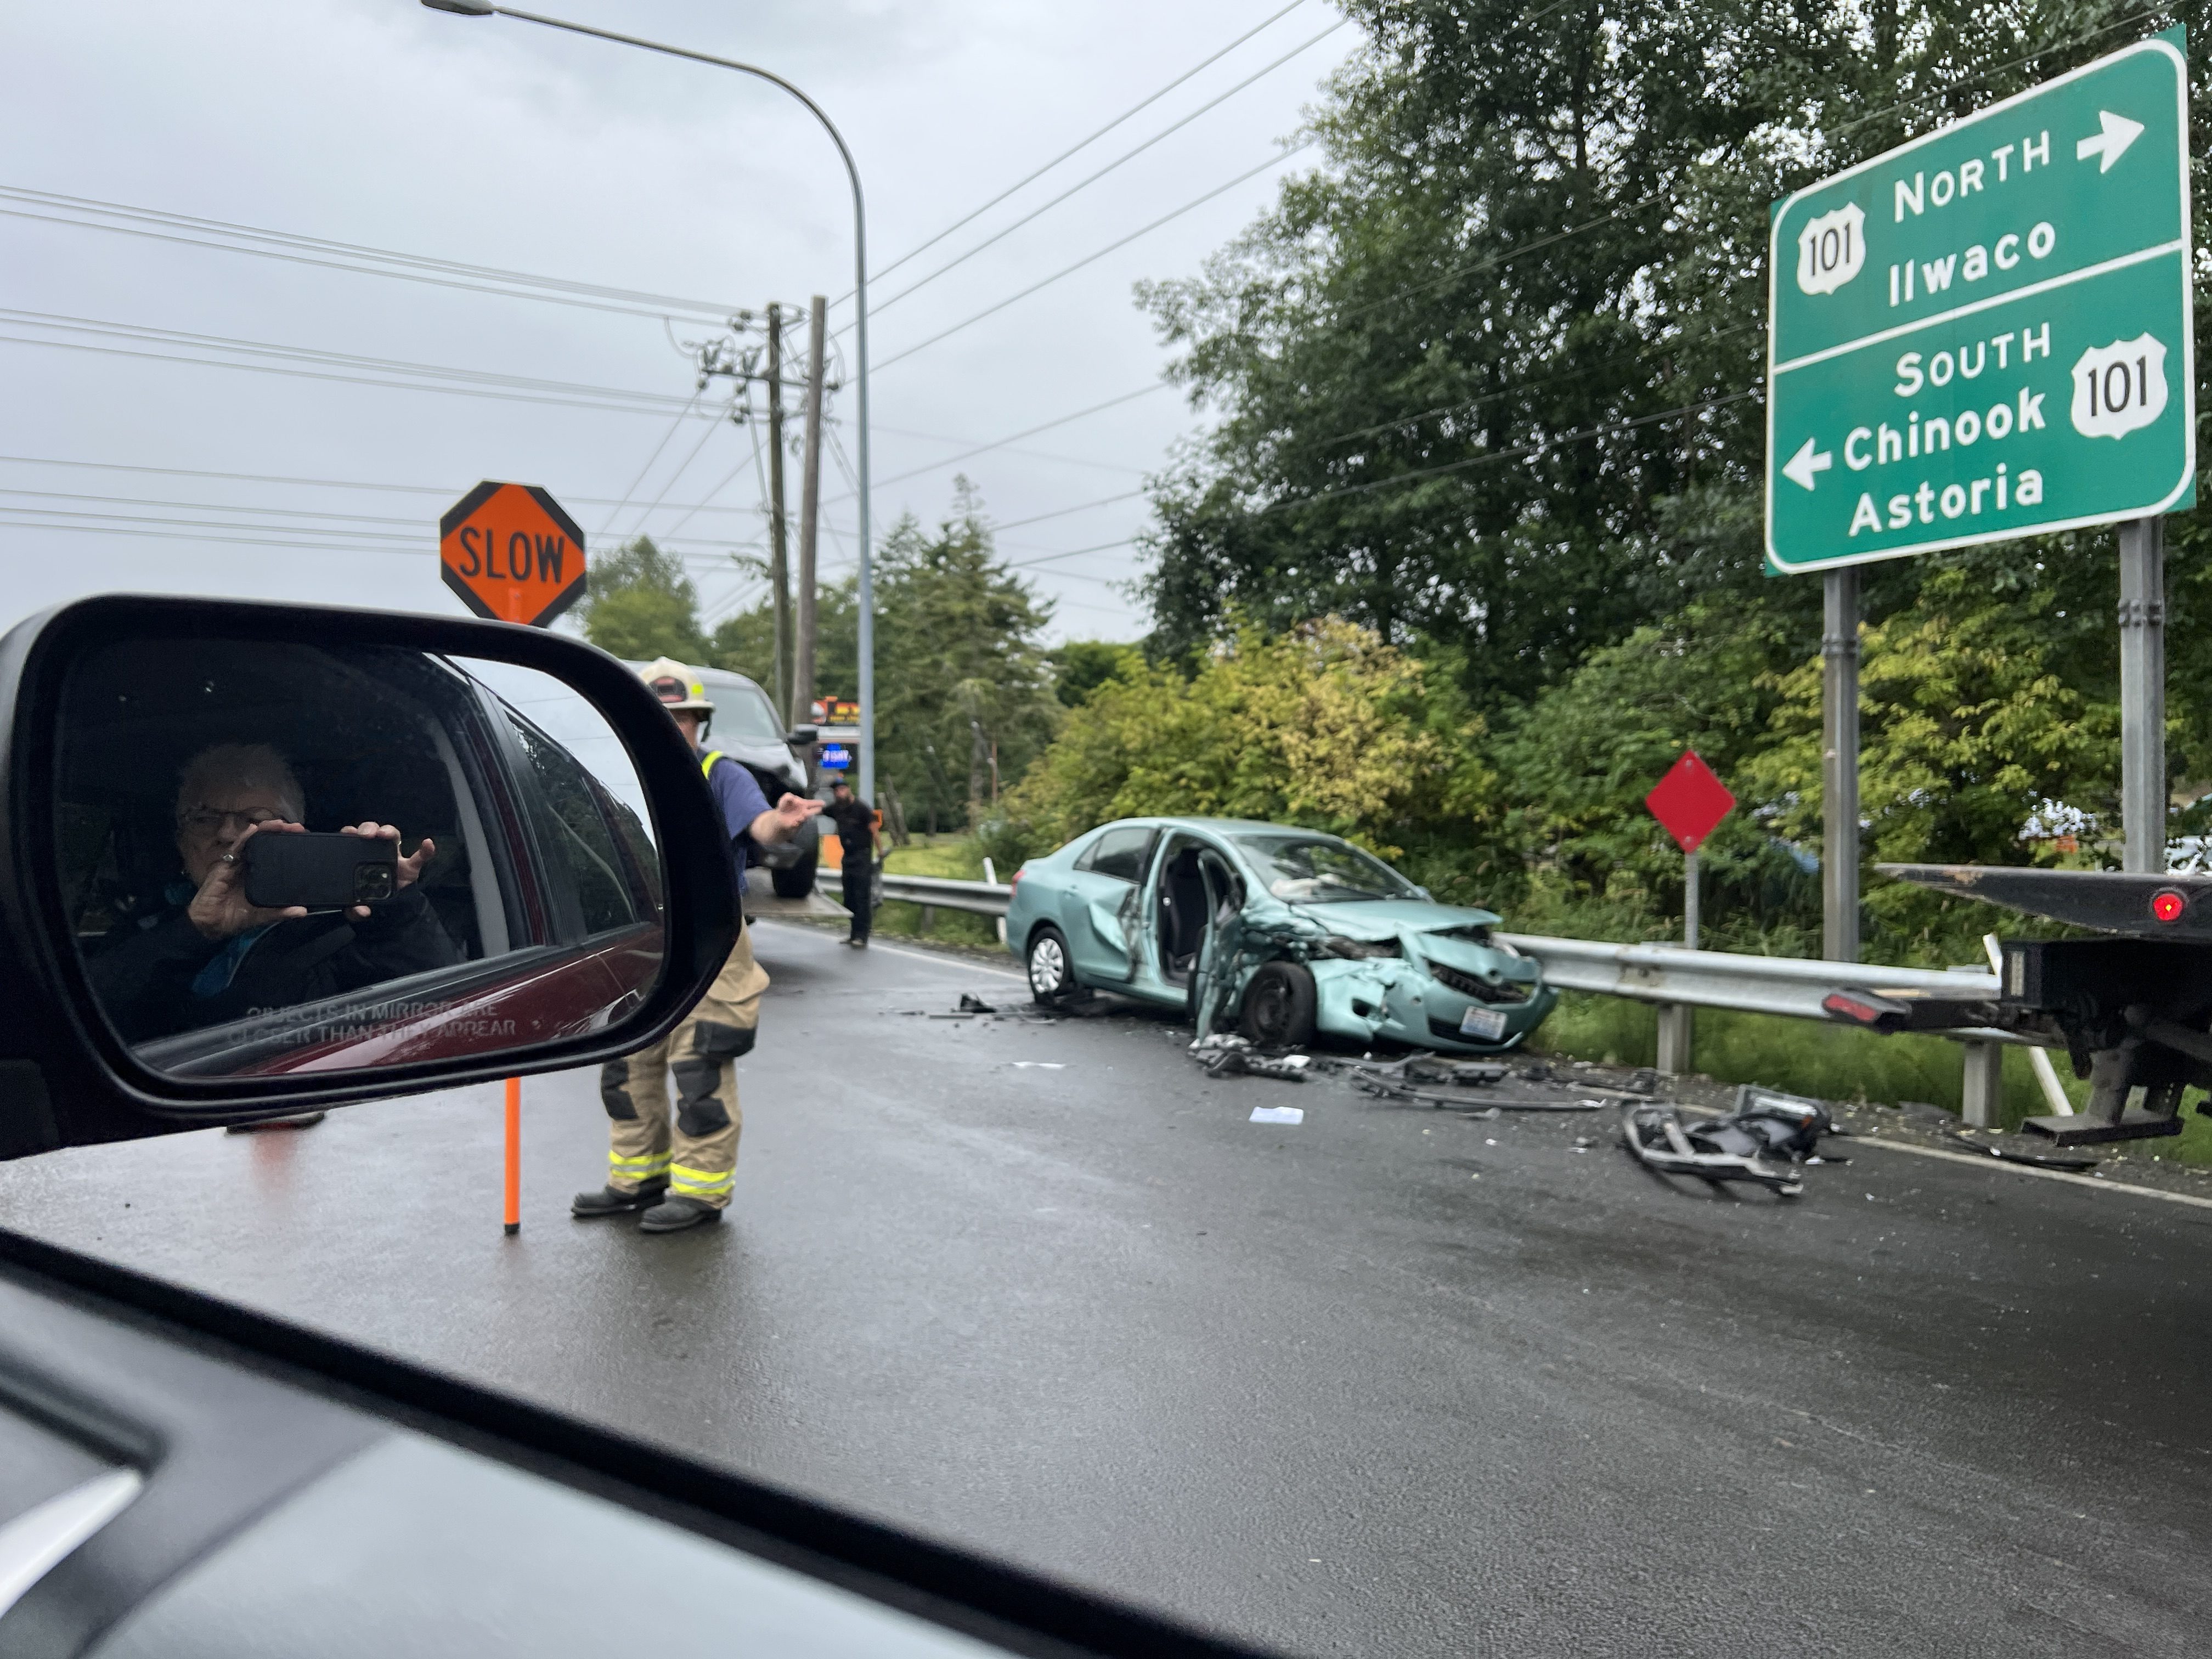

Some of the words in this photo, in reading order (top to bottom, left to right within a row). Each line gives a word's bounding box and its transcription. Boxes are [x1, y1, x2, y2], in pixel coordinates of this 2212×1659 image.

[1894, 129, 2050, 223] NORTH
[1810, 222, 1851, 276] 101
[1889, 221, 2056, 308] Ilwaco
[1894, 321, 2051, 397] SOUTH
[2087, 356, 2147, 417] 101
[1844, 386, 2046, 471] Chinook
[1848, 462, 2043, 537] Astoria
[459, 527, 564, 584] SLOW
[318, 1024, 373, 1042] THAN
